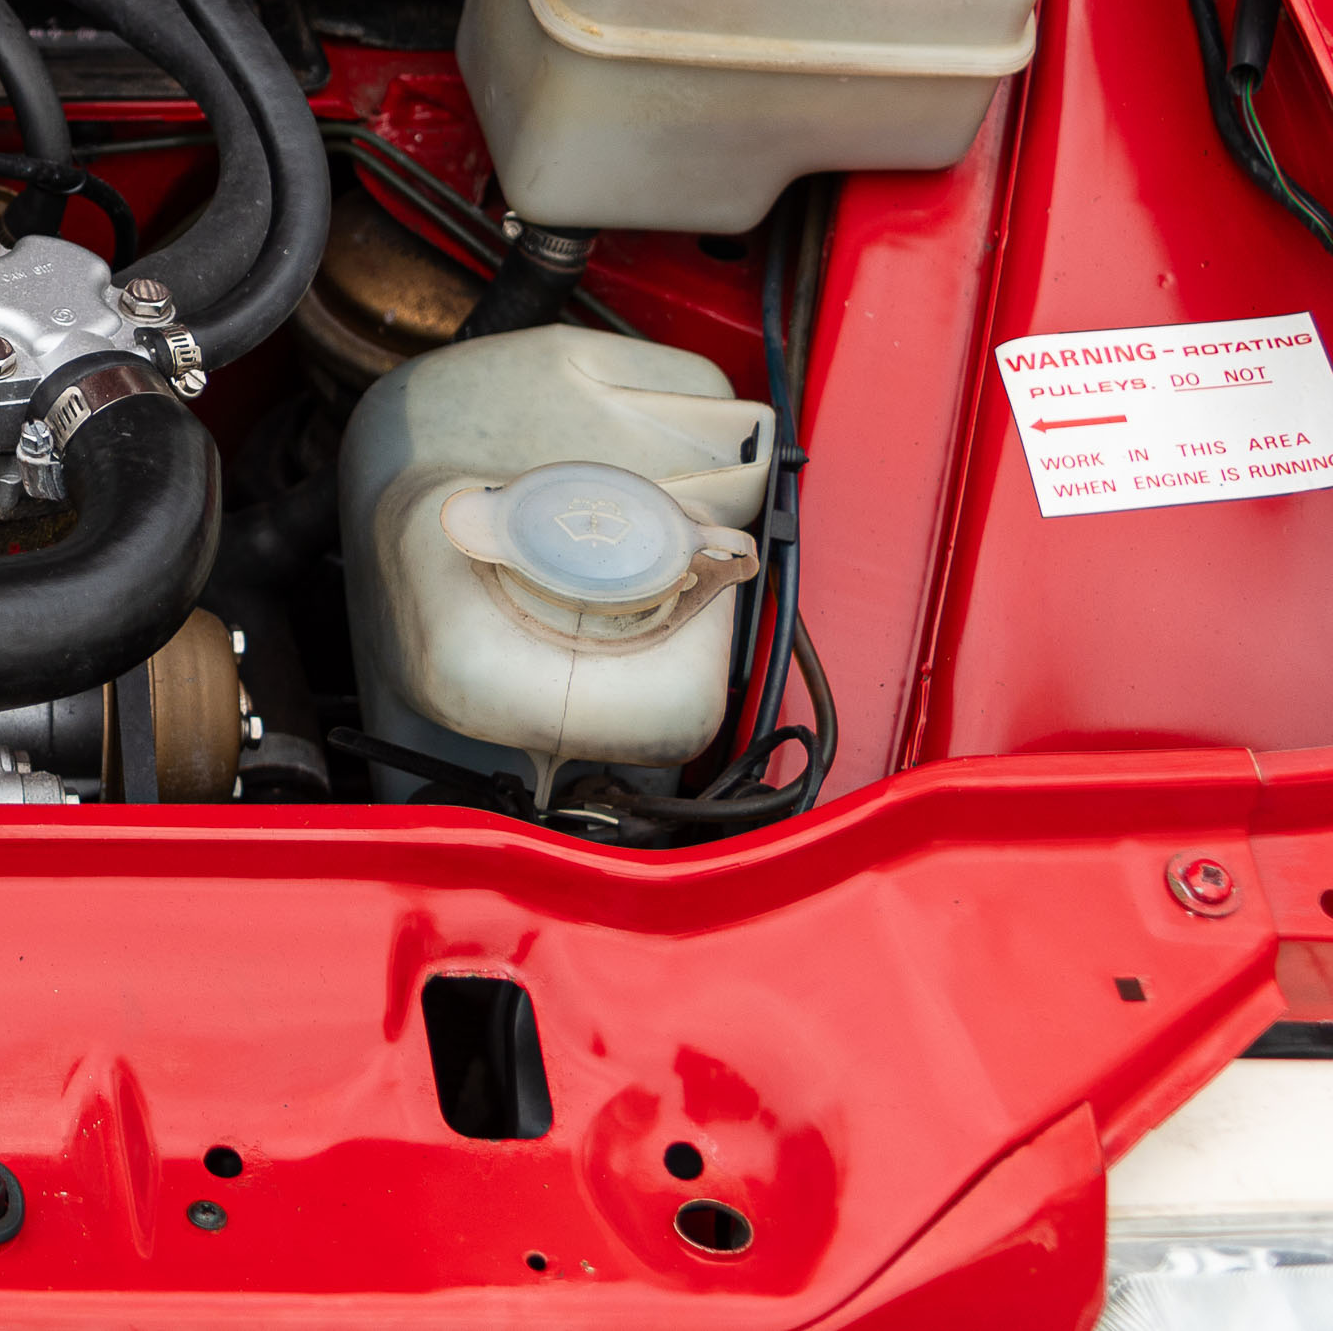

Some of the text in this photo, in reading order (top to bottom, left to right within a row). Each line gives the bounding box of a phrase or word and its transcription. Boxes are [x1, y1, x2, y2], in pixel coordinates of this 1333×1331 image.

[1004, 342, 1157, 373] WARNING
[1182, 332, 1314, 358] ROTATING
[1029, 365, 1268, 399] PULLEYS. DO NOT
[1039, 431, 1312, 472] WORK IN THIS AREA
[1053, 478, 1118, 499] WHEN
[1133, 469, 1211, 490] ENGINE
[1221, 467, 1241, 482] IS
